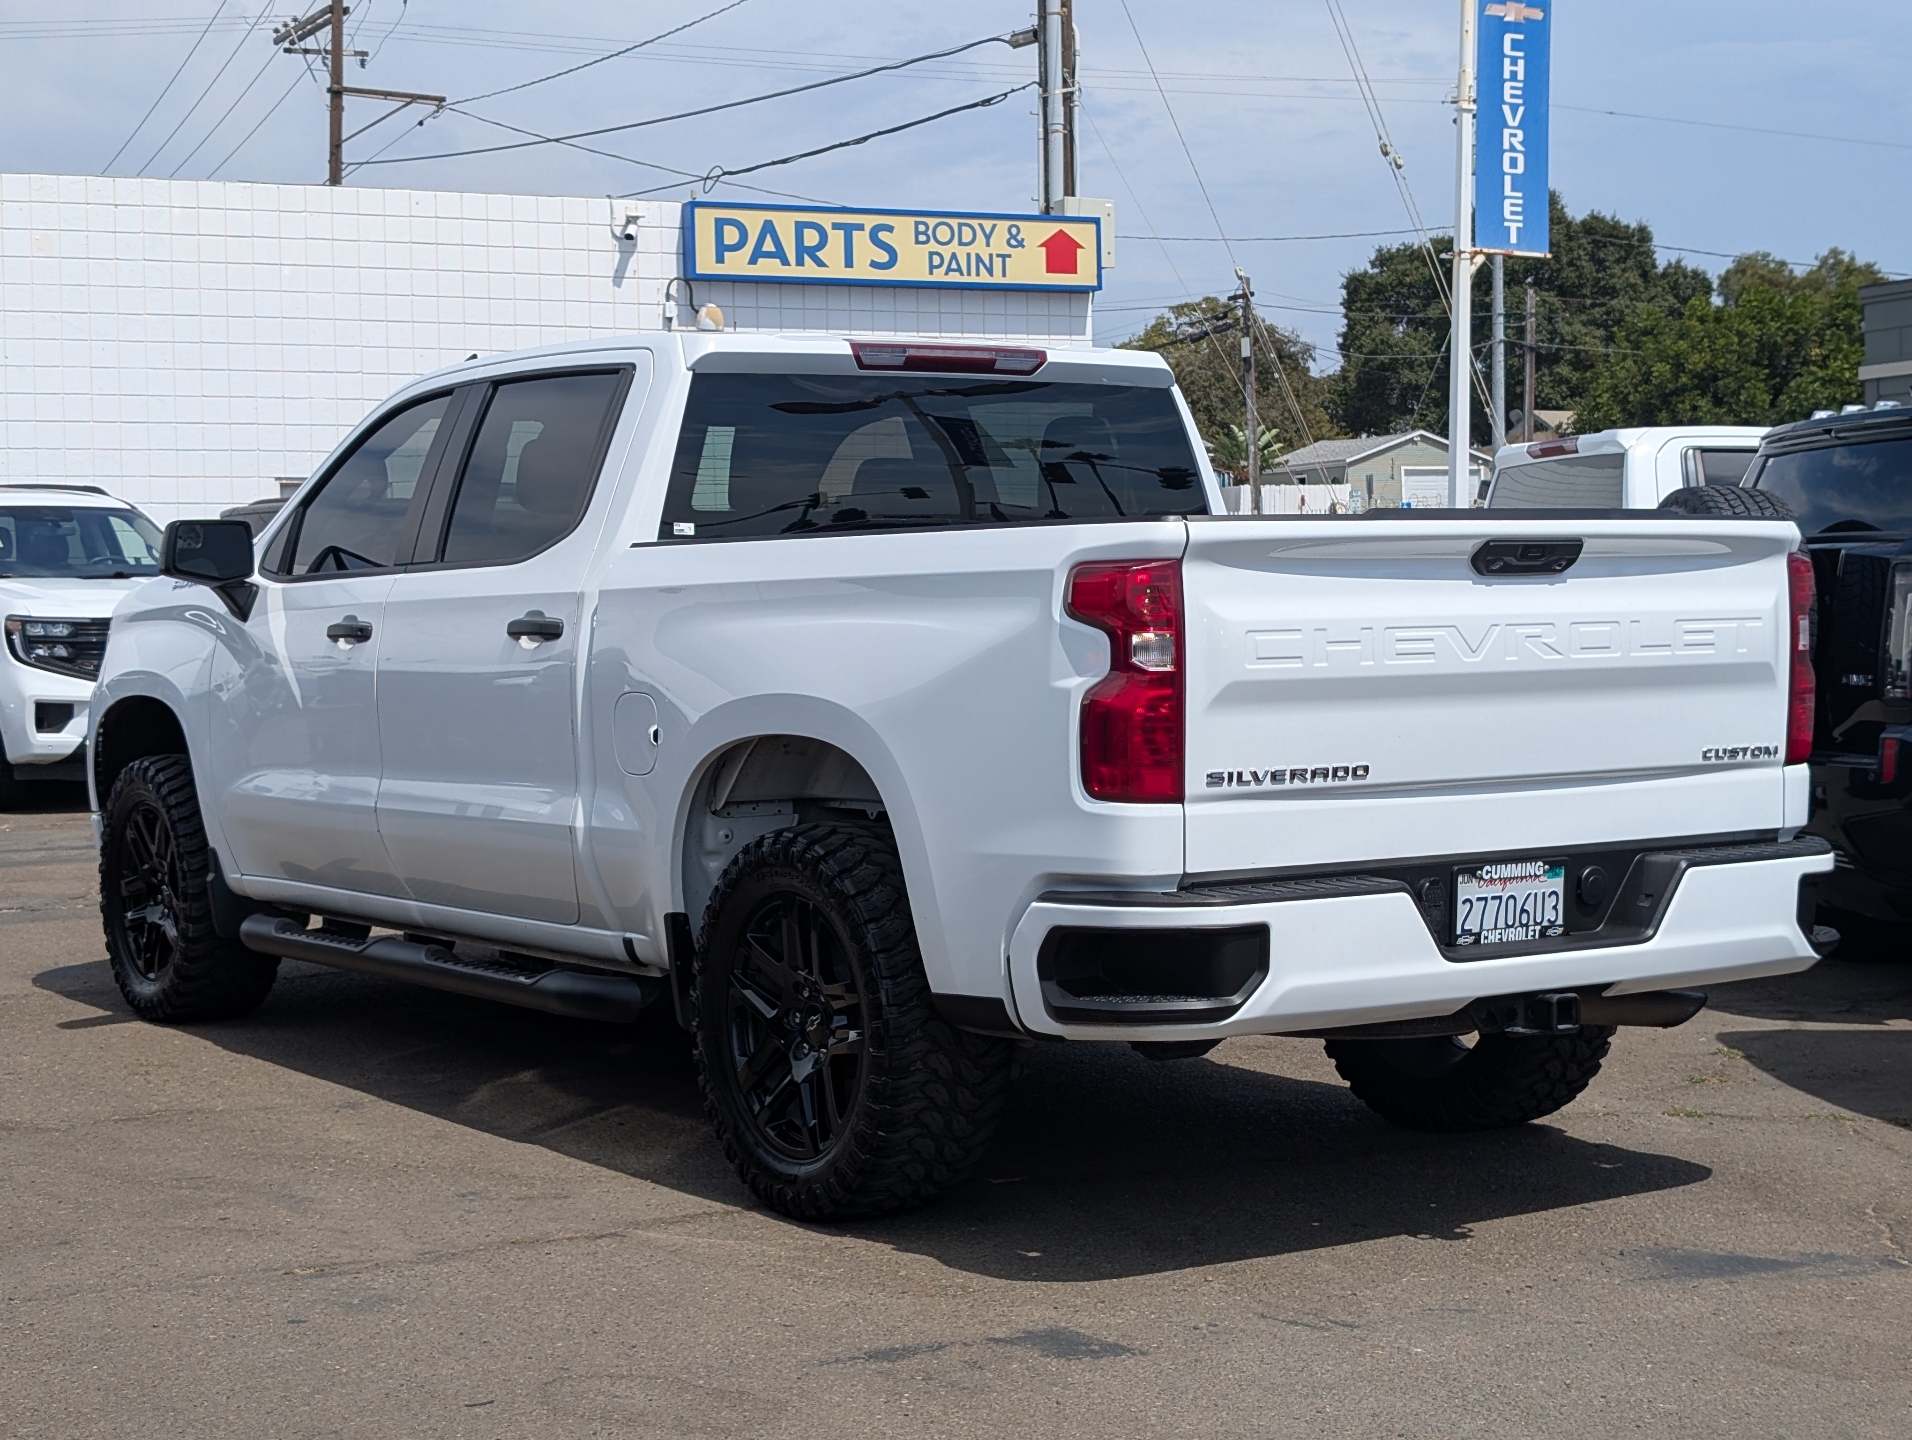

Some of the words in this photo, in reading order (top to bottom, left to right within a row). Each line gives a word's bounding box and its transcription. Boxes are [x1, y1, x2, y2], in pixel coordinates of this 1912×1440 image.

[1502, 32, 1526, 244] CHEVROLET
[714, 217, 899, 270] PARTS
[914, 220, 997, 248] BODY
[1006, 223, 1026, 250] &
[927, 251, 1012, 278] PAINT
[1245, 616, 1763, 669] CHEVROLET
[1702, 745, 1779, 762] CUSTOM
[1206, 763, 1370, 788] SILVERADO
[1482, 861, 1544, 880] CUMMING
[1460, 889, 1560, 934] 27706U3
[1480, 925, 1542, 945] CHEVROLET
